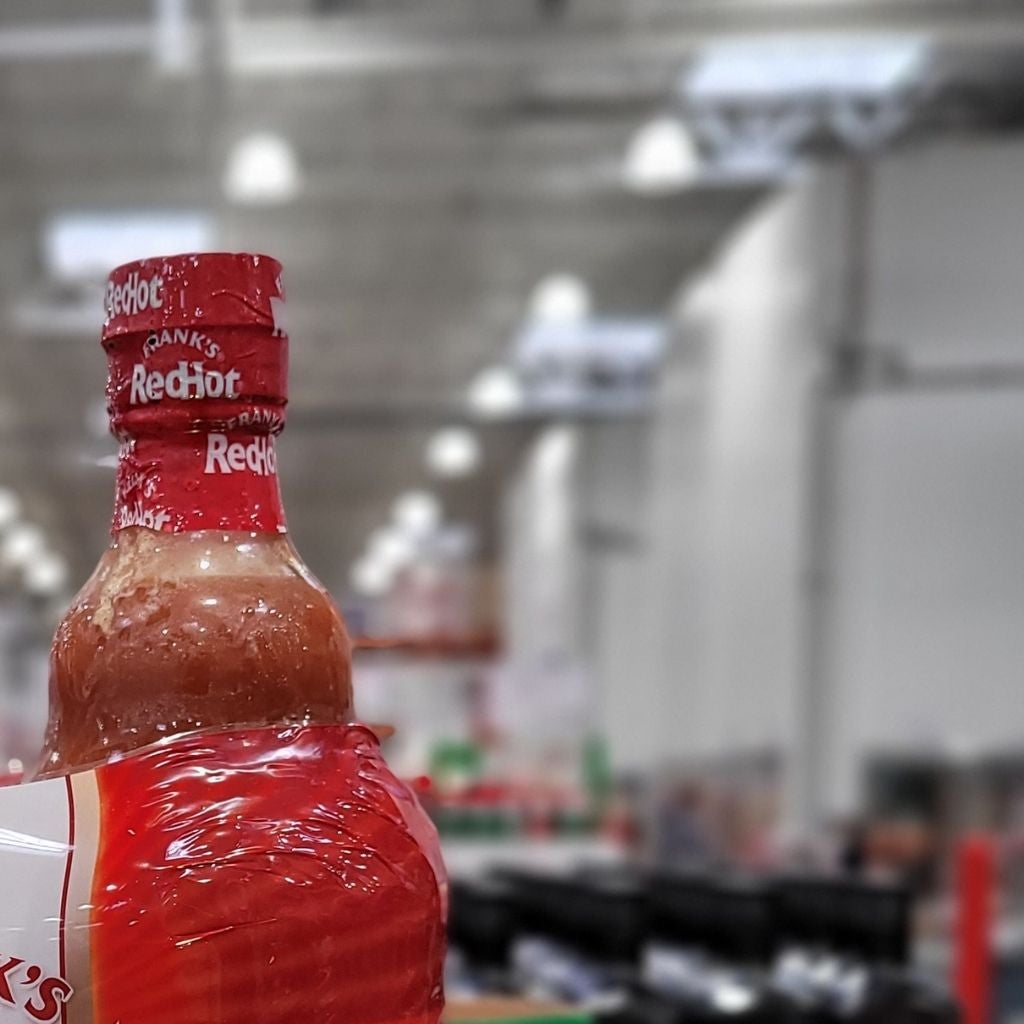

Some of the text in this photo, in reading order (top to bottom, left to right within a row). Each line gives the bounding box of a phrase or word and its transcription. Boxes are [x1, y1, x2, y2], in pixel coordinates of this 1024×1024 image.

[104, 272, 164, 319] RedHot
[130, 361, 241, 404] RedHot
[204, 434, 277, 476] RedHo
